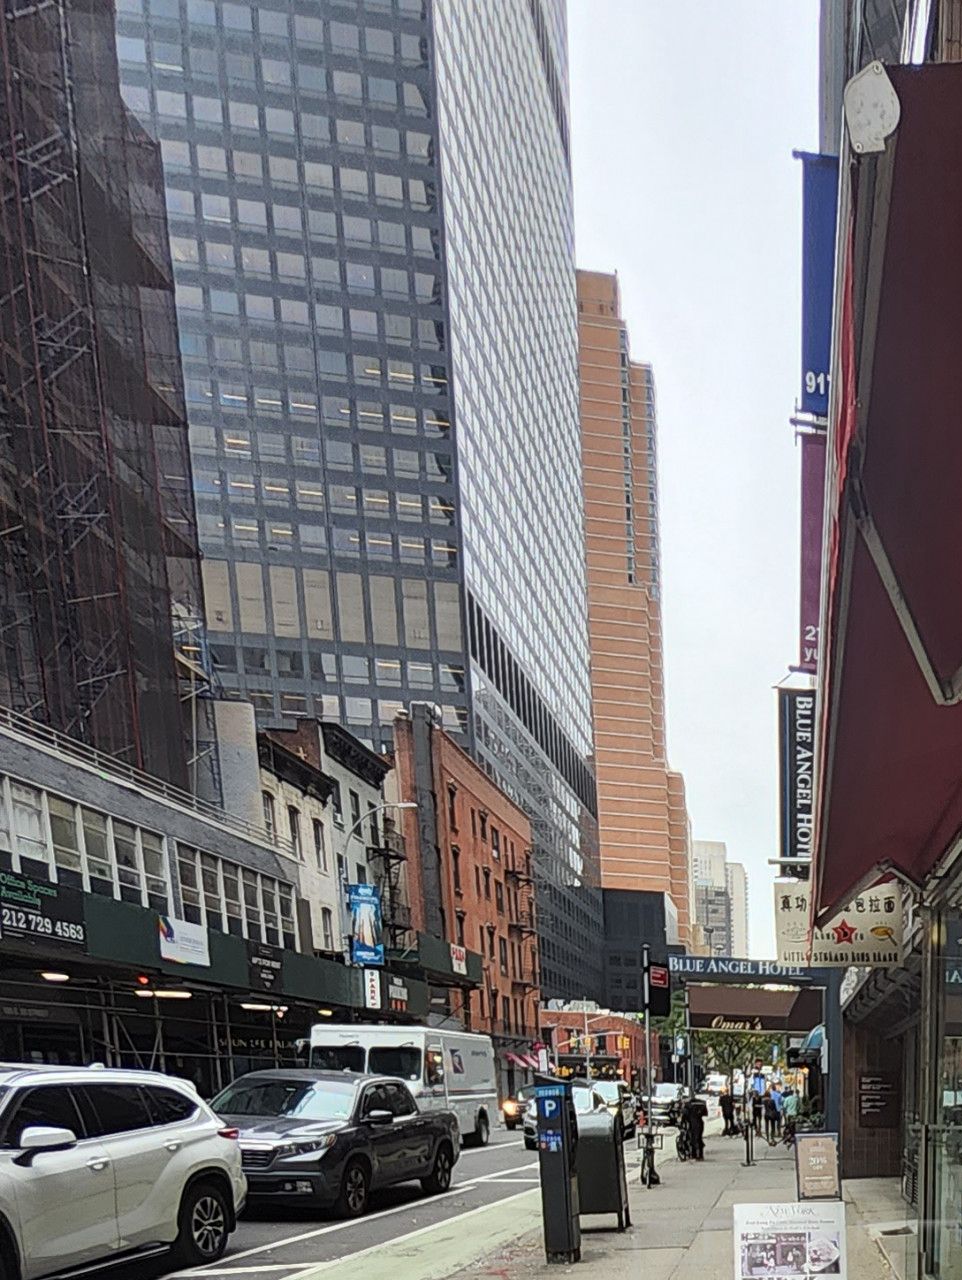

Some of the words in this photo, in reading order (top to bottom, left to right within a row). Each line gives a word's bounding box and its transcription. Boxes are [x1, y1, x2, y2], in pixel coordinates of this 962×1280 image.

[805, 371, 830, 395] 91
[796, 696, 813, 743] BLUE
[796, 746, 813, 809] ANGEL
[2, 908, 27, 929] 212
[30, 915, 52, 934] 729
[54, 921, 84, 941] 4563
[668, 957, 704, 973] BLUE
[707, 959, 756, 975] ANGEL
[758, 962, 804, 976] HOTEL
[711, 1016, 763, 1030] Omar's
[545, 1100, 556, 1117] P
